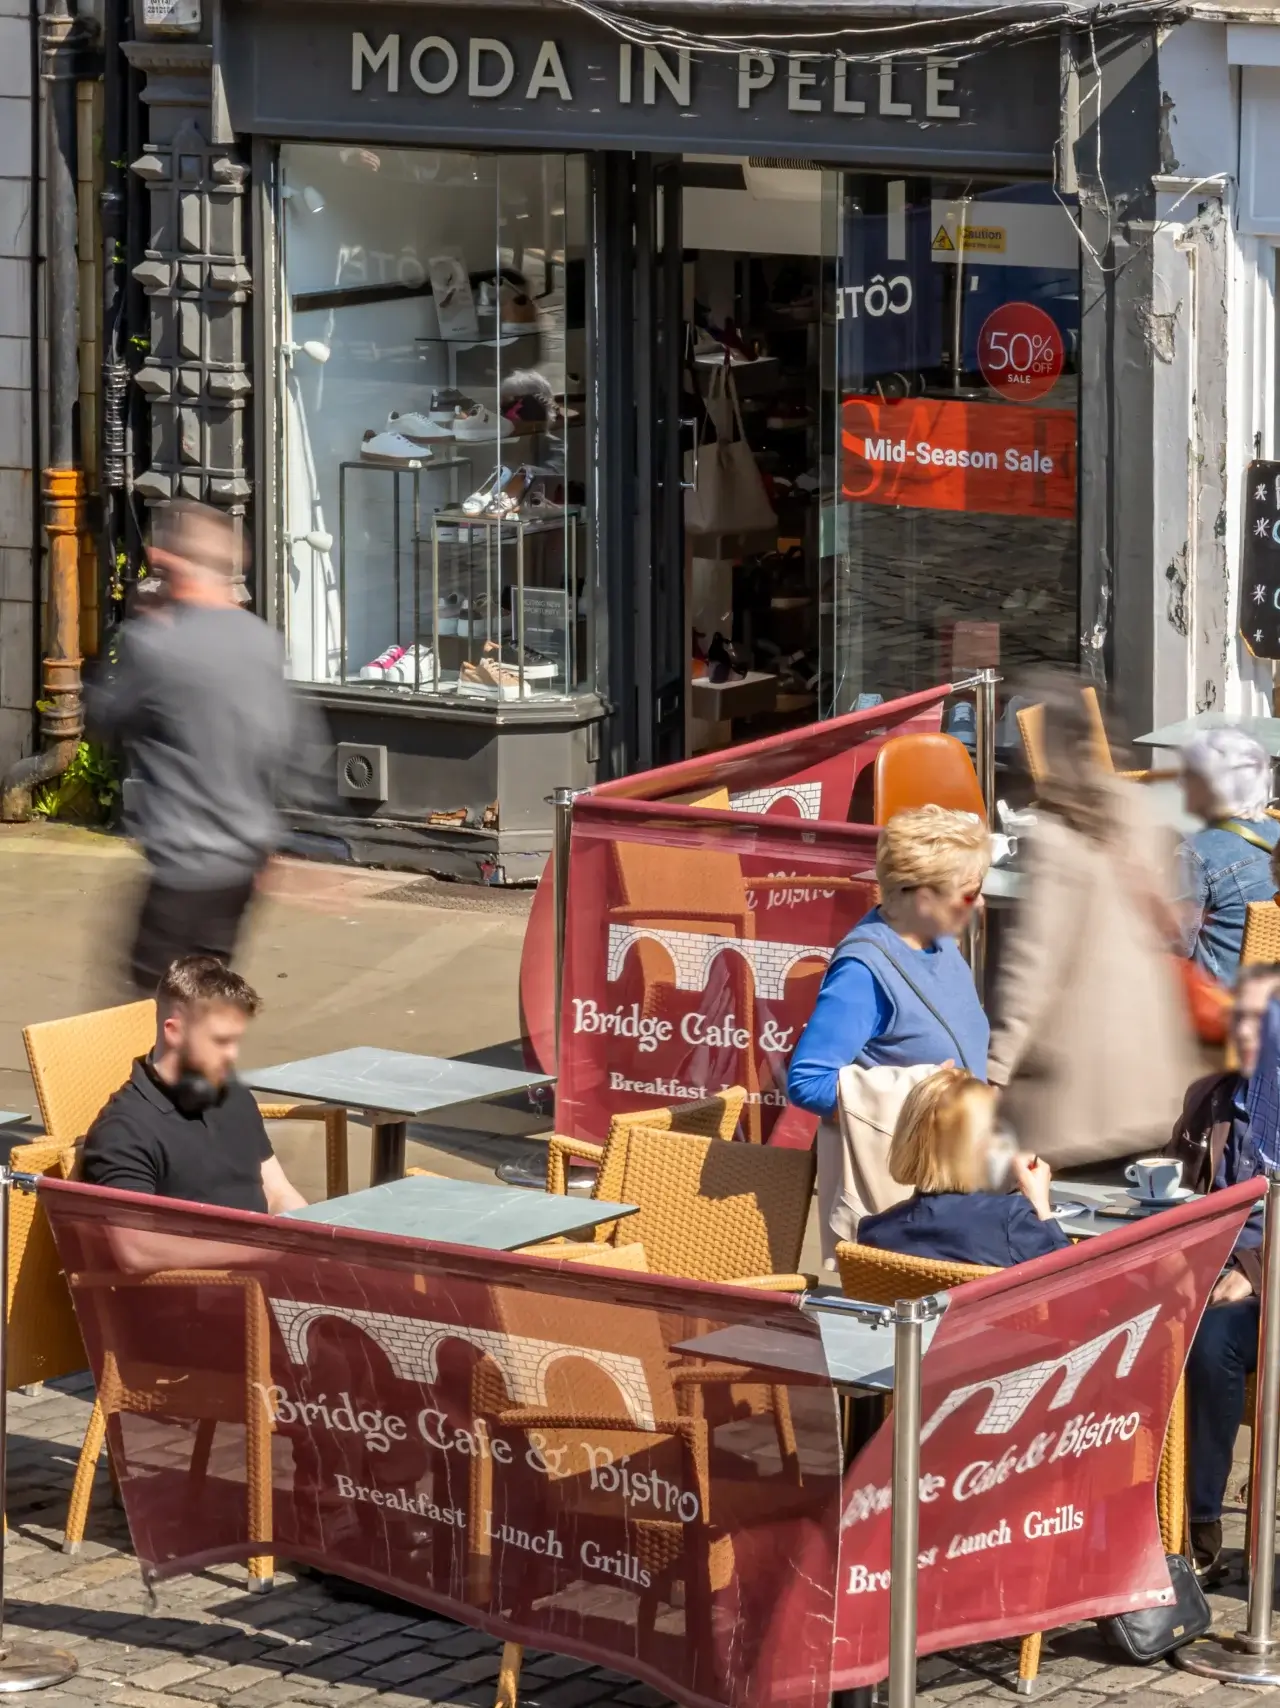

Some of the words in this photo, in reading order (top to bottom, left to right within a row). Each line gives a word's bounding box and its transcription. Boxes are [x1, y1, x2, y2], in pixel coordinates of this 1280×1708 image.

[352, 32, 573, 100] MODA
[619, 43, 692, 106] IN
[738, 50, 960, 118] PELLE
[988, 331, 1054, 372] 50%
[1032, 362, 1053, 374] OFF
[1007, 374, 1031, 384] SALE
[864, 437, 998, 470] Mid-Season
[1004, 447, 1053, 474] Sale
[572, 998, 673, 1052] Bridge
[681, 1011, 750, 1050] Cafe
[759, 1020, 794, 1053] &
[610, 1071, 708, 1100] Breakfast
[252, 1382, 408, 1453] Bridge
[417, 1408, 513, 1464] Cafe
[525, 1432, 572, 1477] &
[581, 1442, 700, 1523] Bistro
[1048, 1411, 1140, 1464] Bistro
[333, 1473, 467, 1530] Breakfast
[483, 1510, 564, 1560] Lunch
[580, 1540, 651, 1588] Grills
[944, 1518, 1012, 1560] Lunch
[1023, 1504, 1085, 1540] Grills
